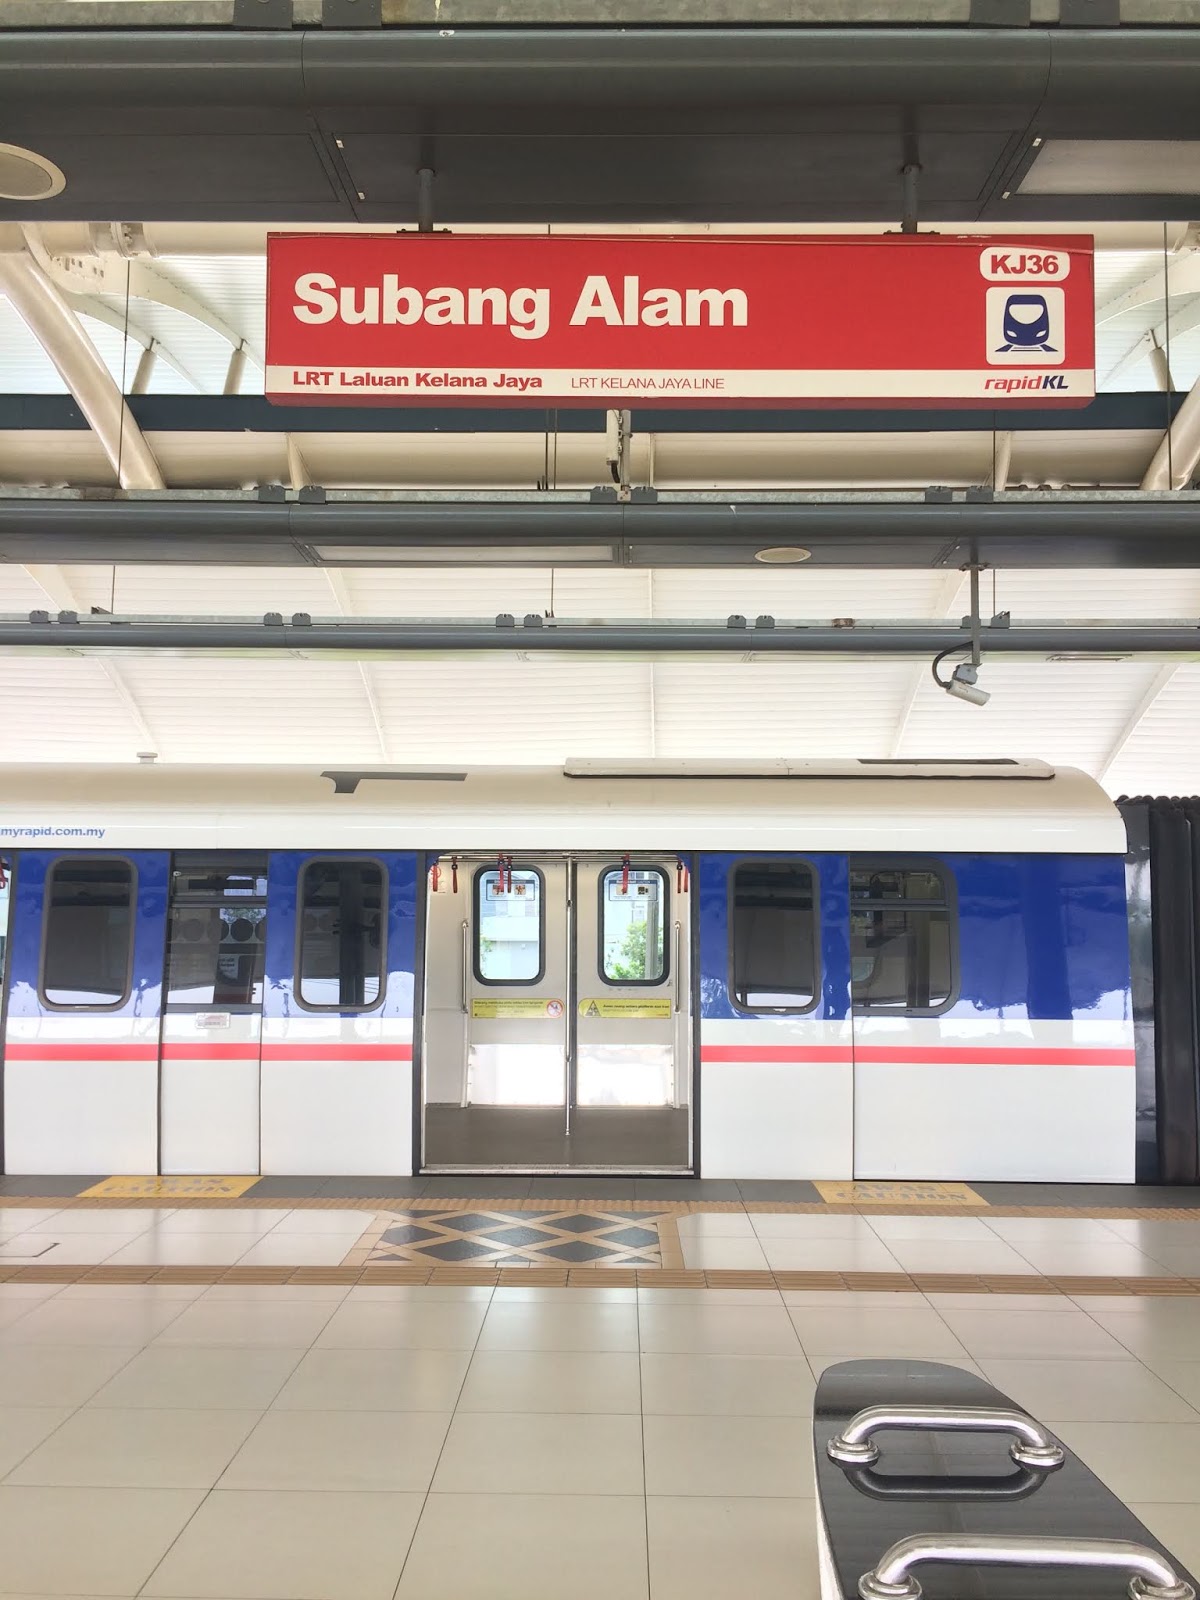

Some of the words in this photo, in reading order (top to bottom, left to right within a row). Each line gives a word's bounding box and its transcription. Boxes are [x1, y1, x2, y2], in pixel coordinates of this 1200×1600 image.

[991, 254, 1059, 274] KJ36
[293, 272, 550, 340] Subang
[569, 275, 748, 327] Alam
[293, 371, 334, 386] LRT
[340, 372, 409, 387] Laluan
[415, 373, 487, 387] Kelana
[493, 374, 542, 391] Jaya
[571, 377, 598, 389] LRT
[600, 377, 656, 389] KELANA
[658, 378, 692, 389] JAYA
[694, 378, 725, 389] LINE
[984, 375, 1069, 393] rapidKL
[0, 827, 106, 838] myrapid.com.my
